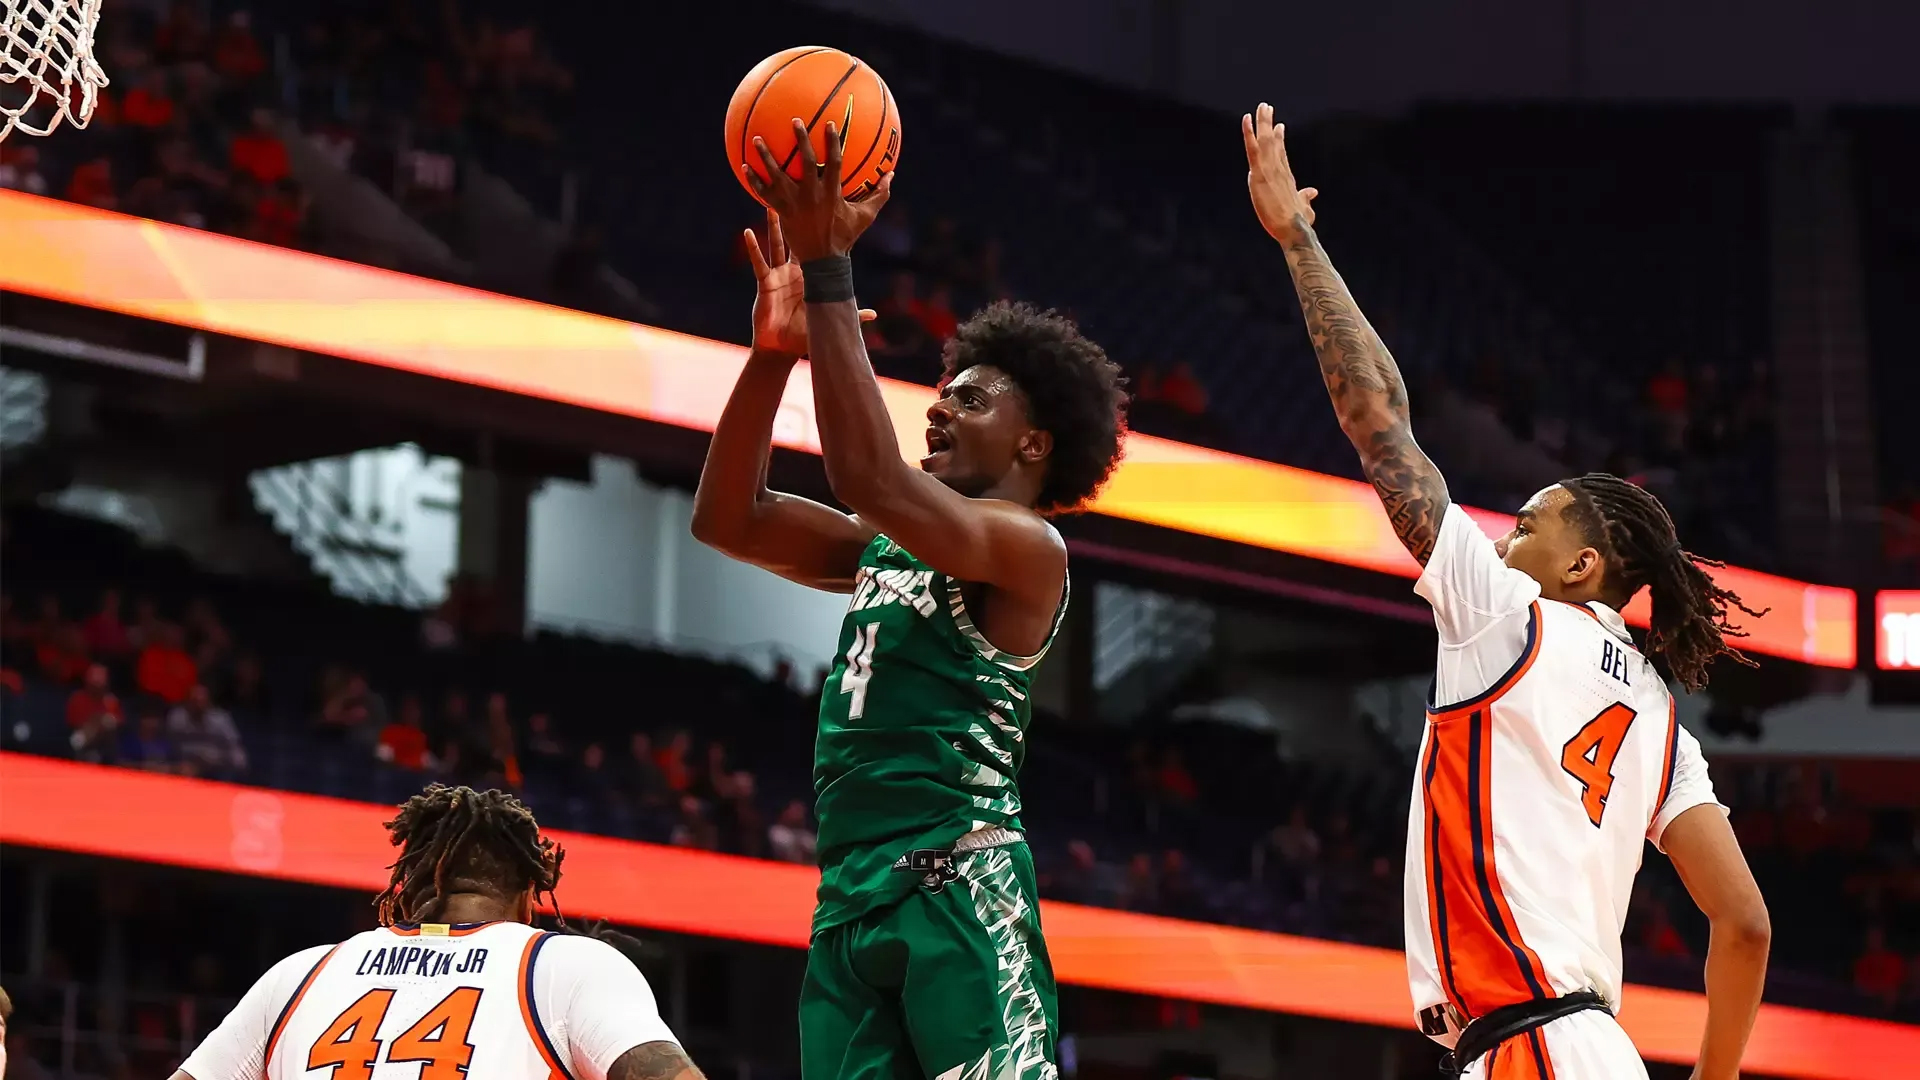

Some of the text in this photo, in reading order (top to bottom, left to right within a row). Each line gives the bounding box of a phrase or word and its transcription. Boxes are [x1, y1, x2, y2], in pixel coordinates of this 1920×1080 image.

[840, 621, 881, 720] 4
[1561, 701, 1638, 829] 4
[355, 946, 488, 977] LAMPKIN JR
[306, 986, 484, 1080] 44
